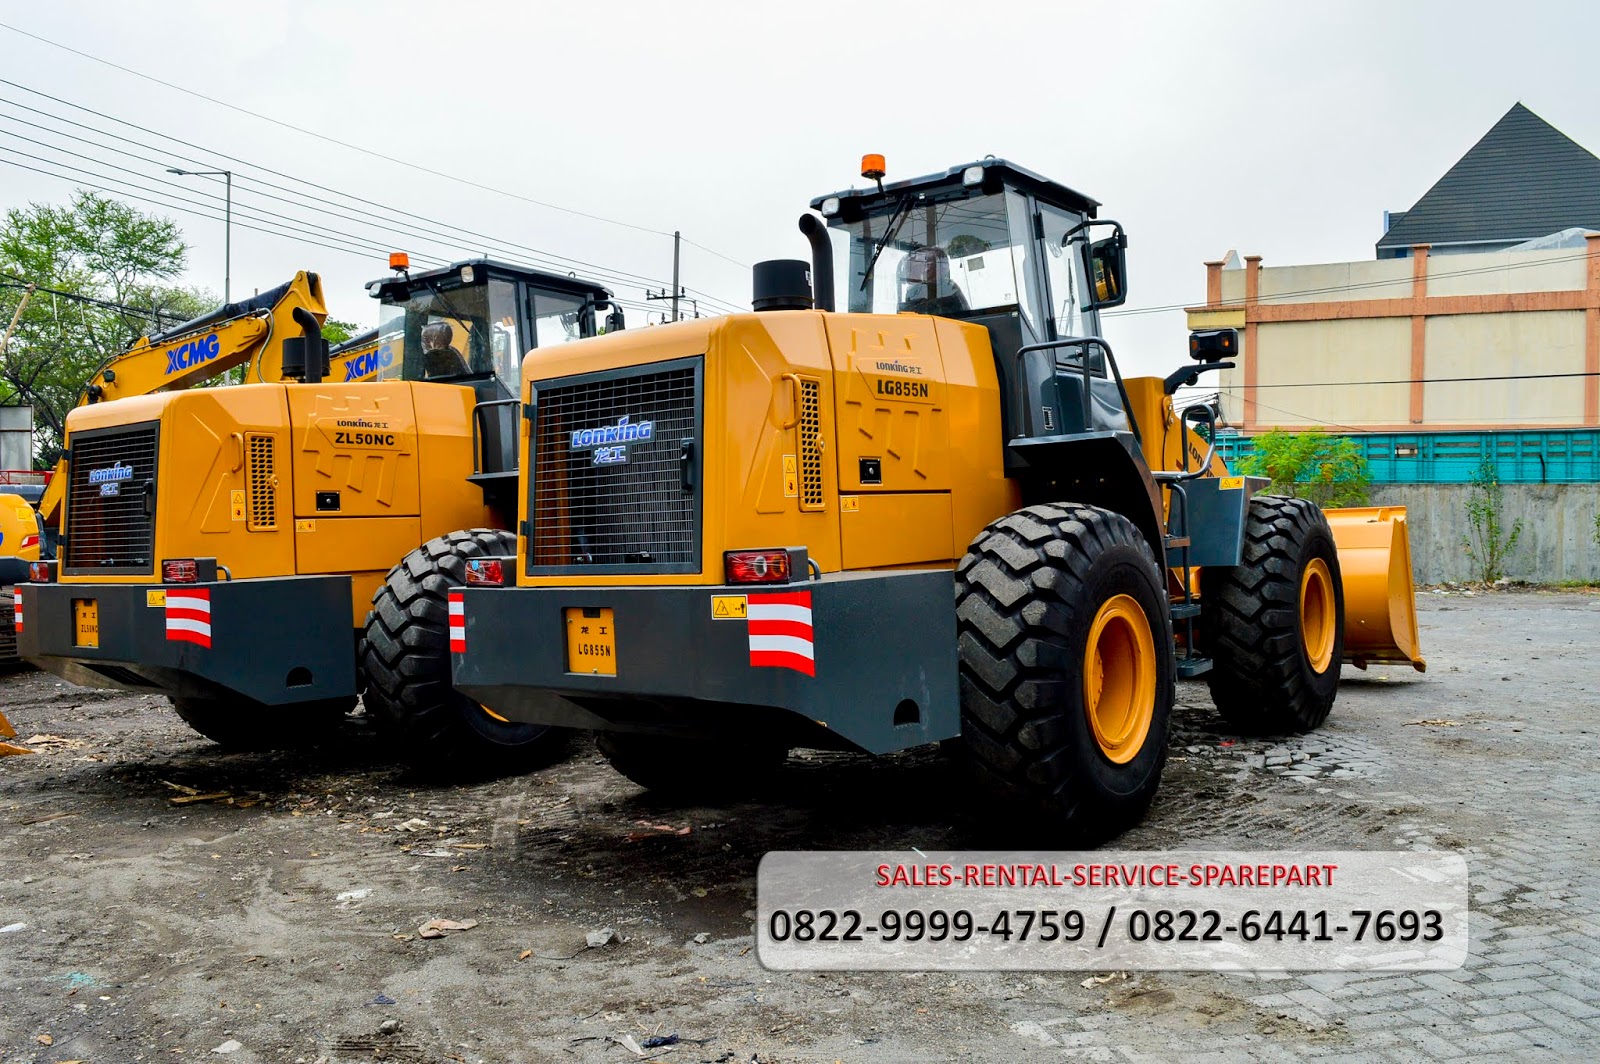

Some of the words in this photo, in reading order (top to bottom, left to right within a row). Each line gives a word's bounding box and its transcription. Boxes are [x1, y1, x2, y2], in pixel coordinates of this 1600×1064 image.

[165, 333, 220, 375] XCMG
[344, 345, 393, 382] XCMG
[877, 379, 929, 398] LG855N
[335, 432, 395, 446] ZL50NC
[594, 446, 626, 465] 龙工
[578, 643, 611, 657] LG855N
